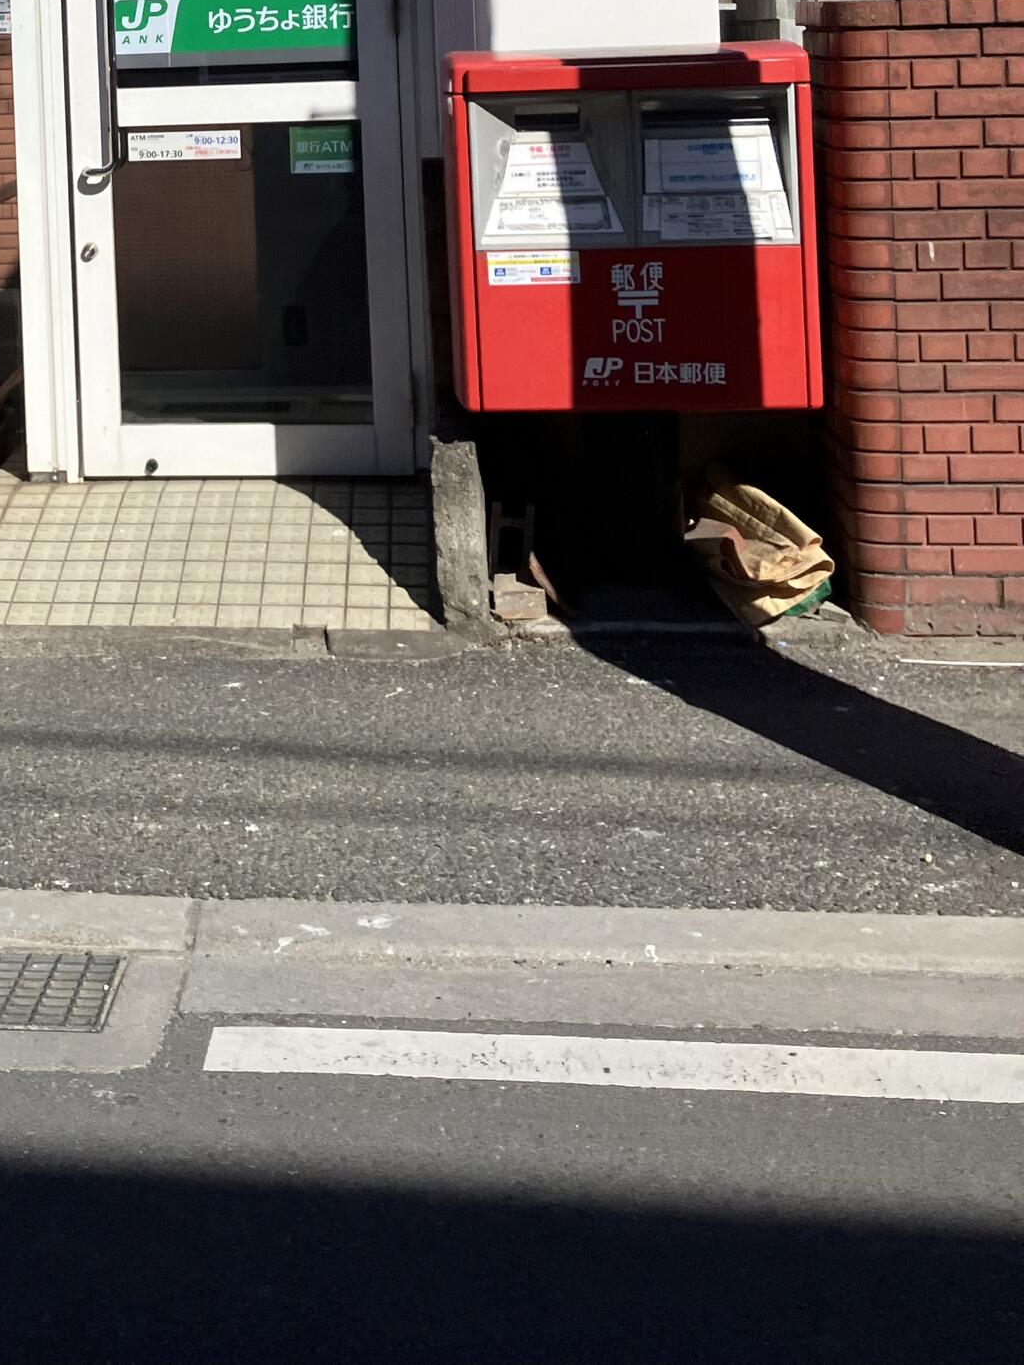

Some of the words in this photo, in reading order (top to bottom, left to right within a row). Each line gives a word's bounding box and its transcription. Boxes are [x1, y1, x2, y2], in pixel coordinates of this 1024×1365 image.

[208, 4, 355, 35] ゆうちょ銀行
[121, 33, 166, 46] ANK
[194, 136, 239, 145] 9:00-12:30
[138, 150, 184, 159] 9:00-17:30
[610, 261, 665, 291] 郵便
[612, 318, 666, 344] POST
[634, 361, 727, 385] 日本郵便
